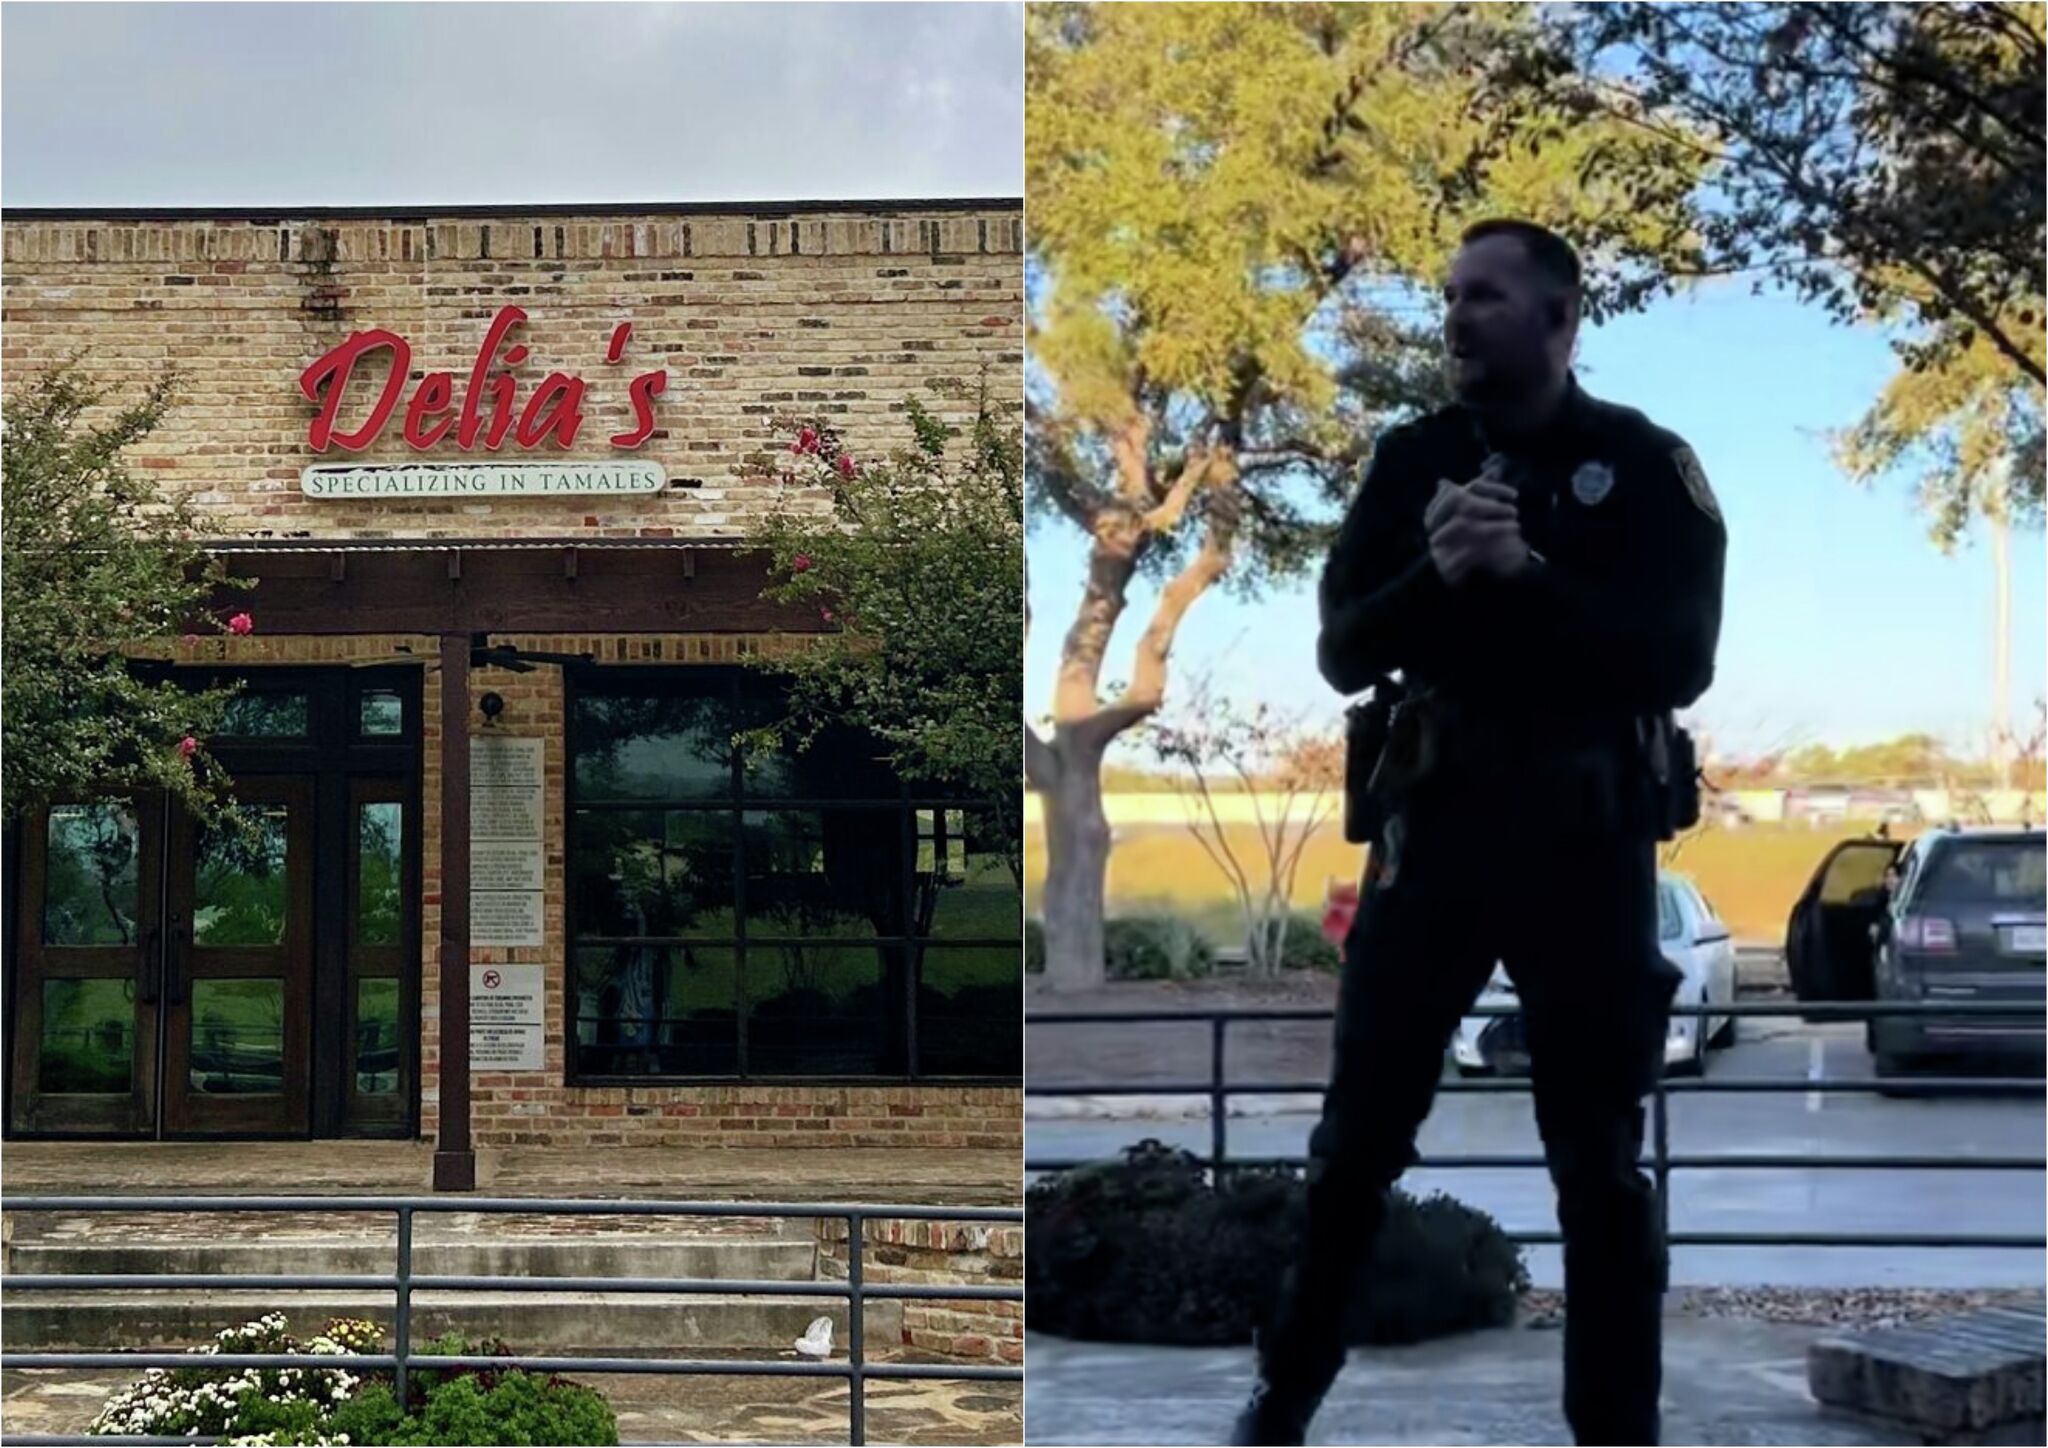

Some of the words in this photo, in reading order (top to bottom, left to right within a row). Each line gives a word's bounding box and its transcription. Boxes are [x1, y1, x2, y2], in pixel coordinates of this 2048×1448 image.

[299, 304, 668, 453] Delia's
[312, 474, 487, 494] SPECIALIZING
[501, 472, 527, 490] IN
[538, 471, 656, 491] TAMALES
